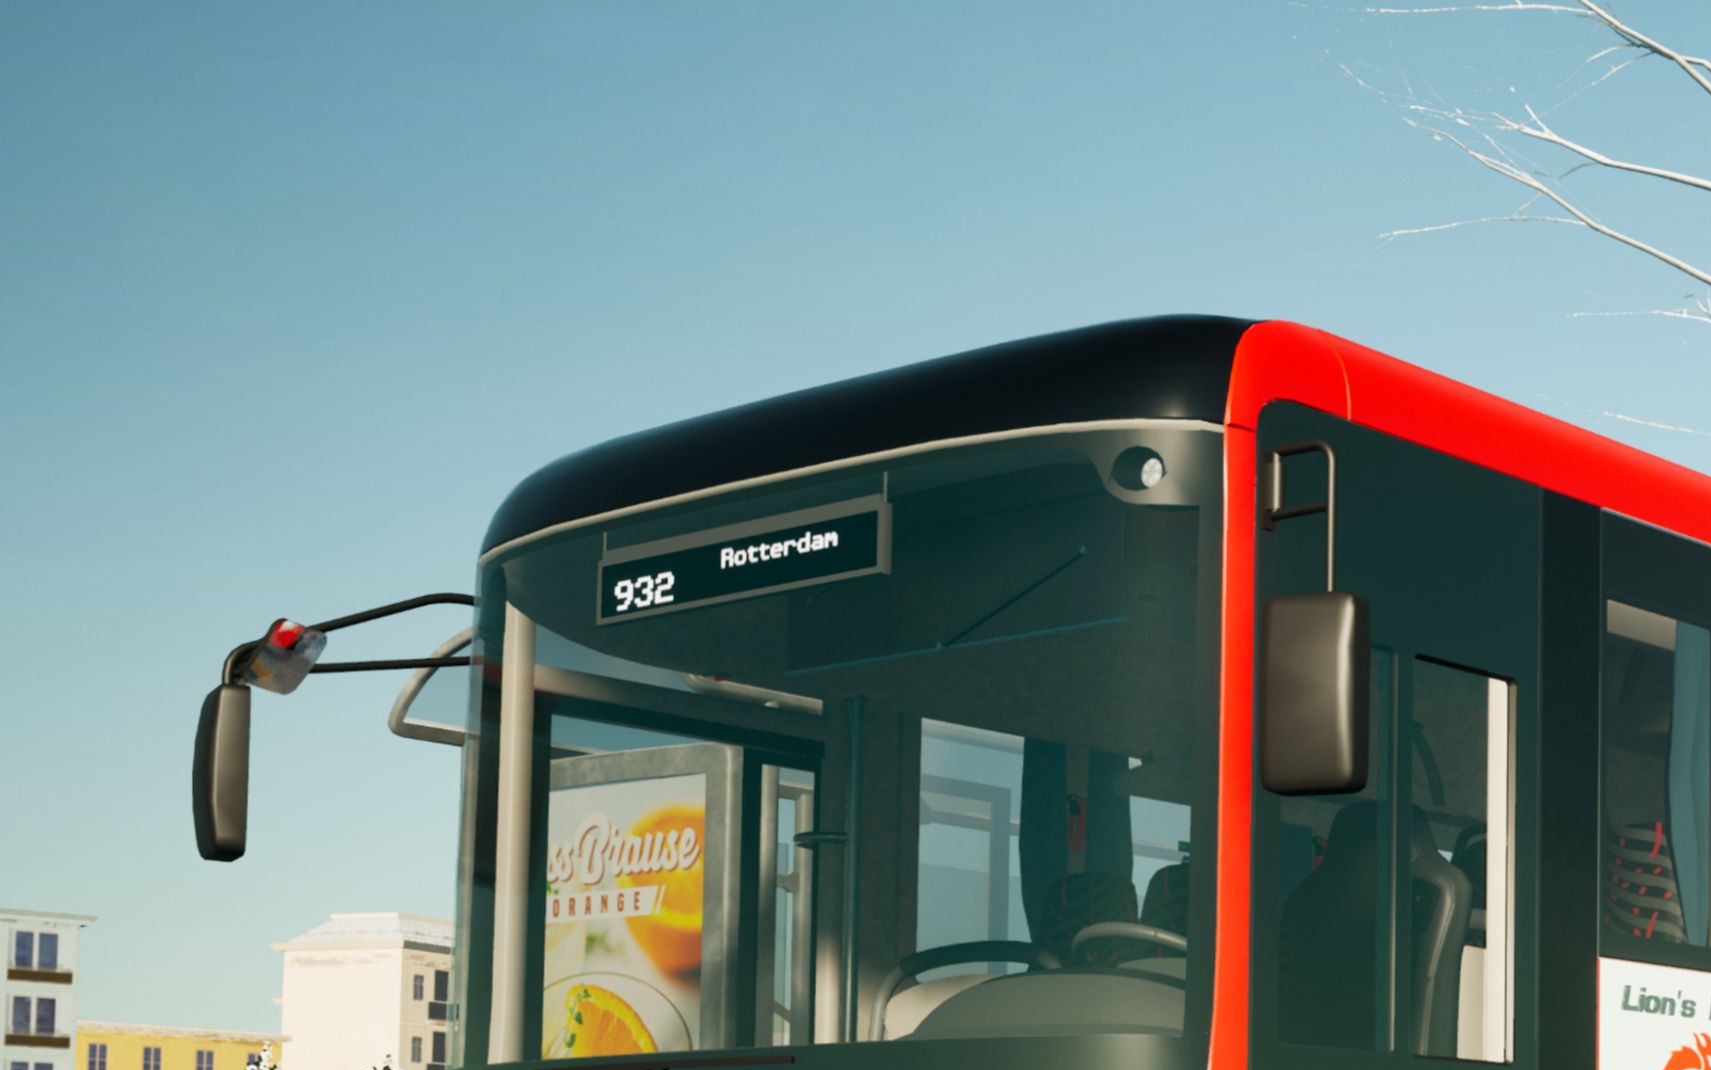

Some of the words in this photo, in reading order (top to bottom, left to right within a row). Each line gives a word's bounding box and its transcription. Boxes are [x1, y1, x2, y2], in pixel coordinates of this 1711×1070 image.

[720, 530, 839, 569] Rotterdam
[614, 570, 675, 612] 932
[552, 891, 641, 919] ORANGE
[1621, 984, 1697, 1018] Lion's
